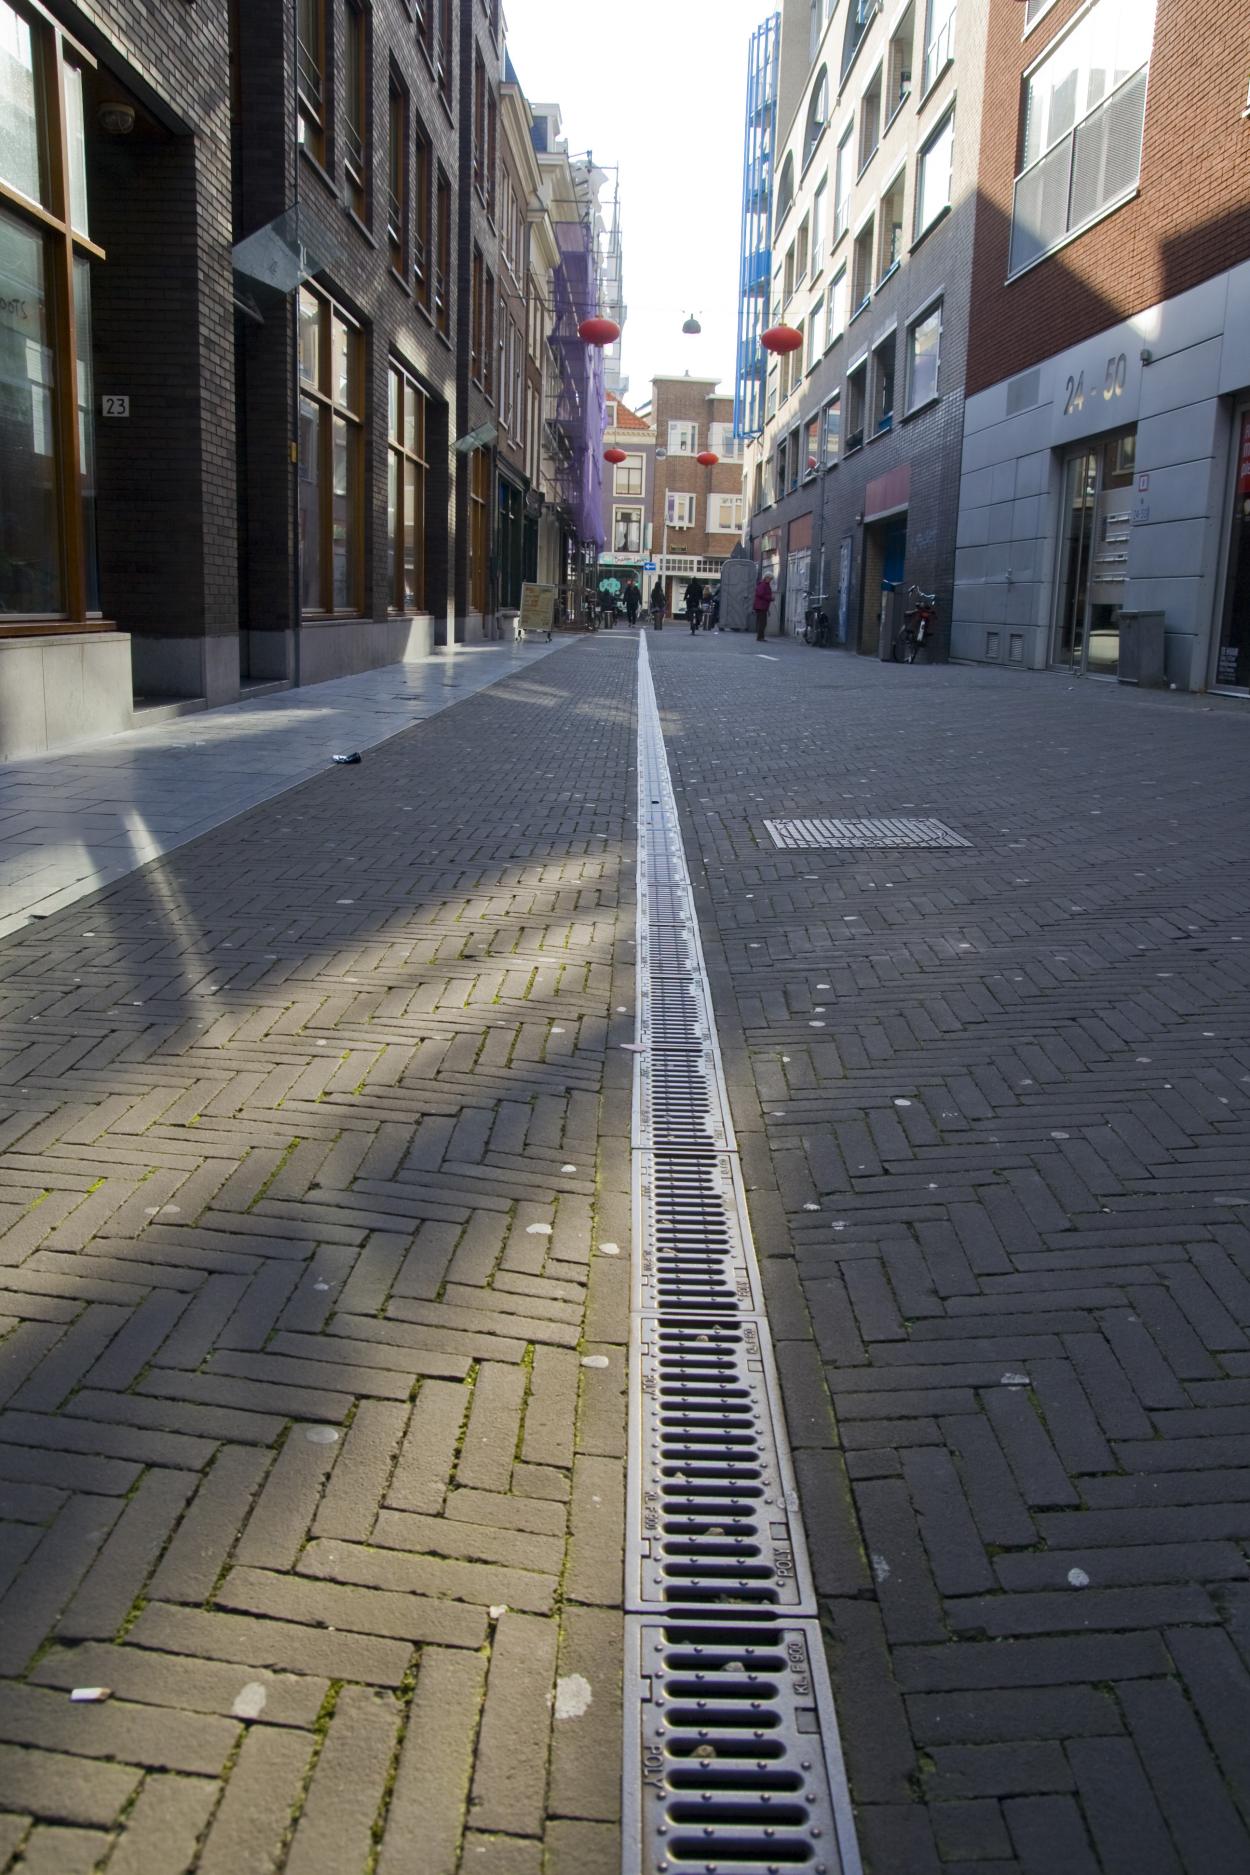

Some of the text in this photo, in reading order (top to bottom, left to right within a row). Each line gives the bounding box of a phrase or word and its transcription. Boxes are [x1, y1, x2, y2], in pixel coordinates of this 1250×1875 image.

[1064, 370, 1085, 416] 24
[1103, 352, 1127, 401] 50
[106, 398, 126, 415] 23
[774, 1547, 794, 1578] POLY
[643, 1745, 664, 1789] POLY
